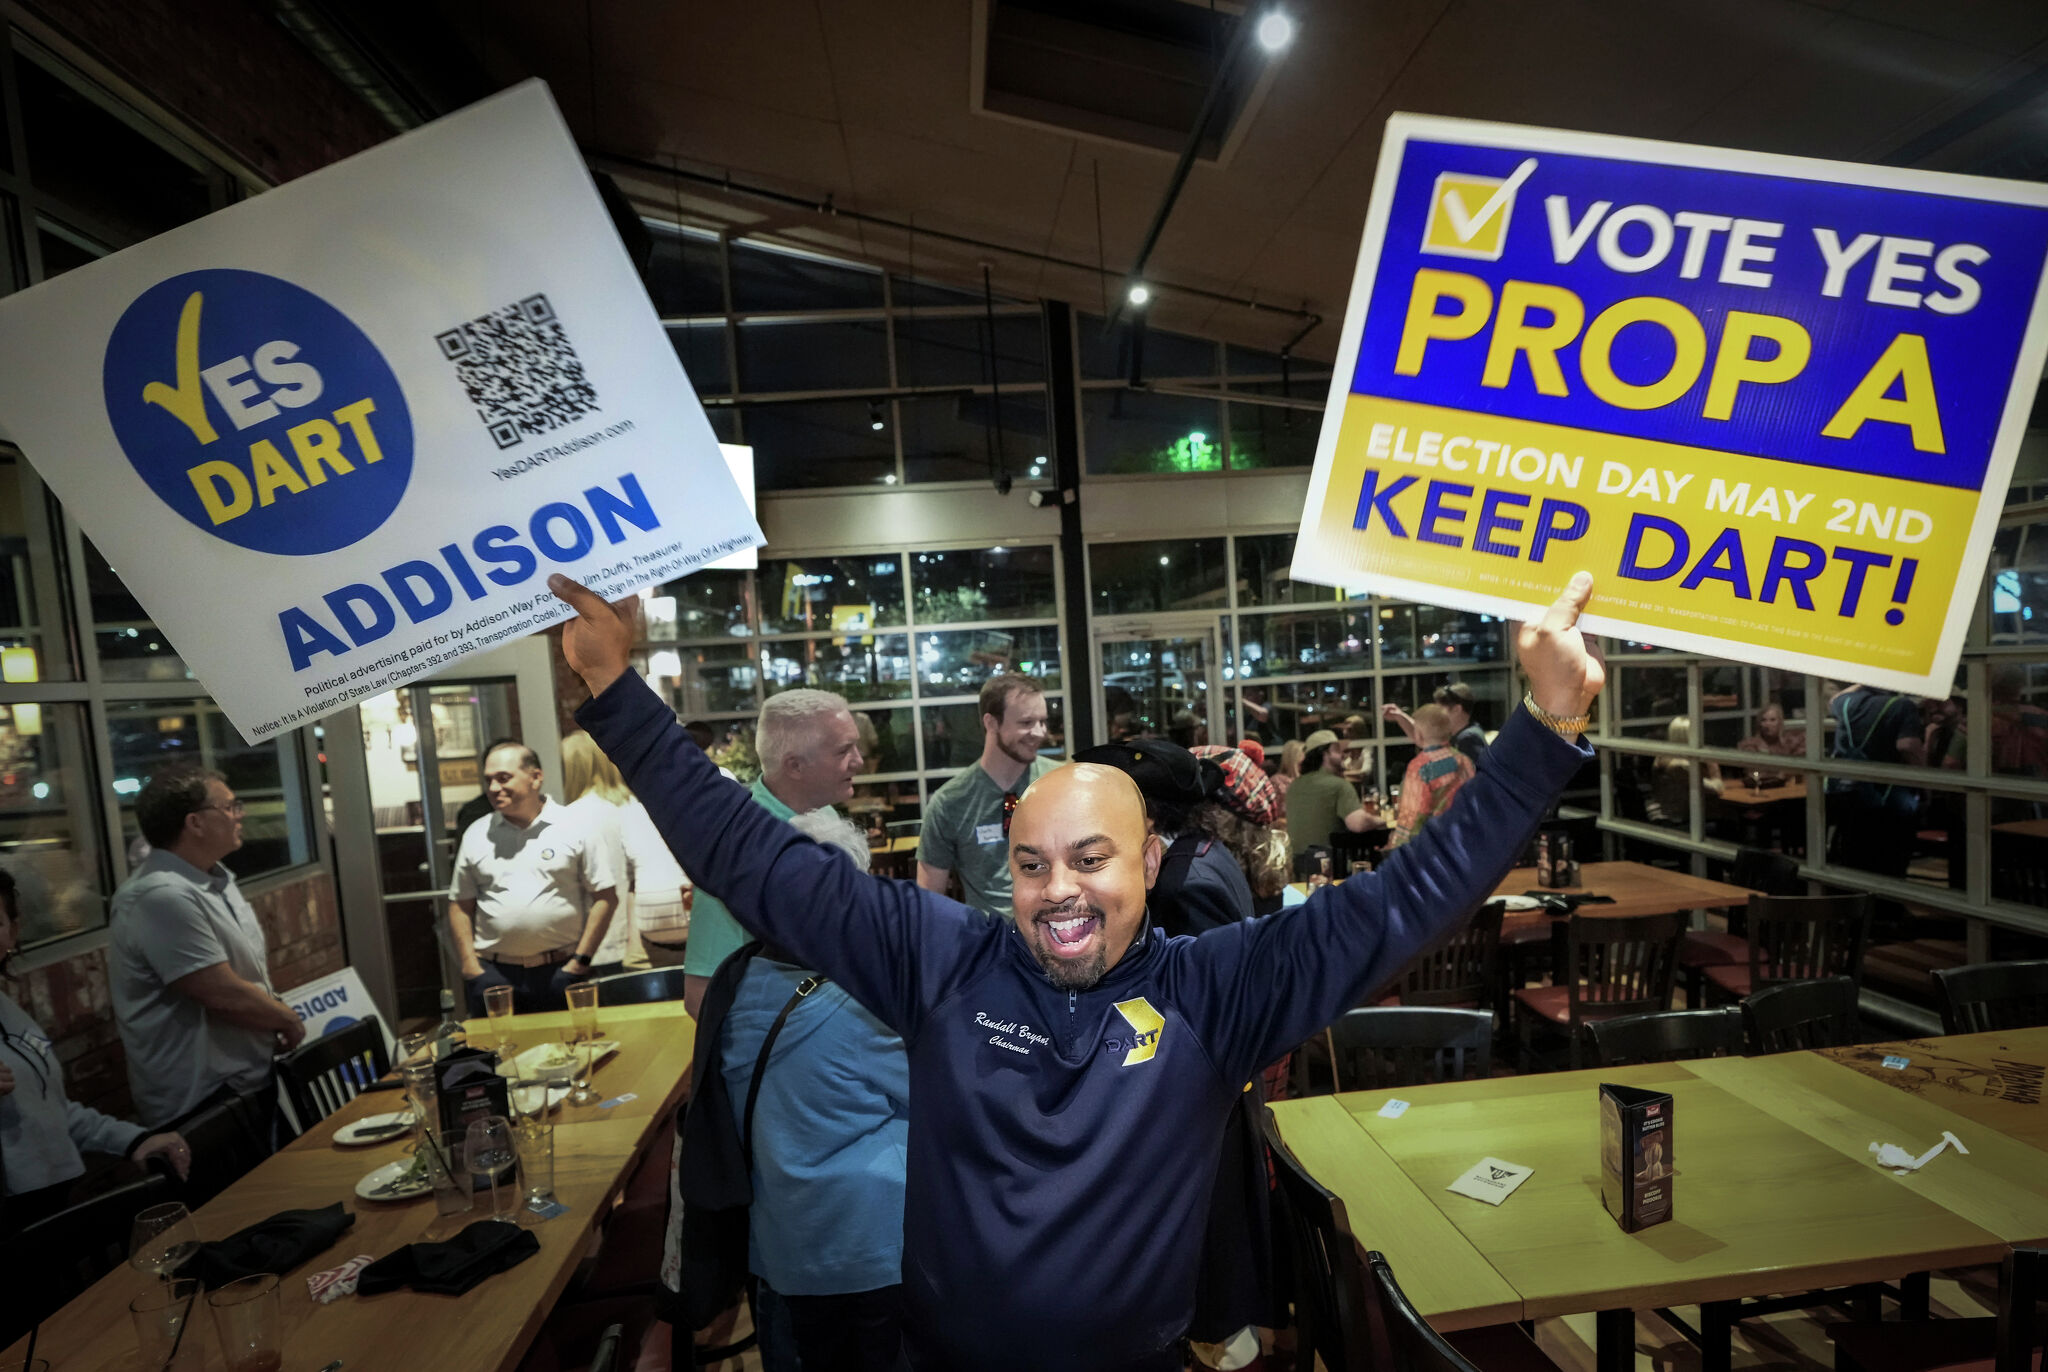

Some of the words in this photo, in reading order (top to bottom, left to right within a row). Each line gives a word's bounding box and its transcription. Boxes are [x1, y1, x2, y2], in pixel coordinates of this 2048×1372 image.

[1545, 195, 1784, 289] VOTE
[1813, 228, 1991, 315] YES
[143, 290, 324, 446] YES
[1394, 268, 1811, 421] PROP
[1821, 333, 1946, 455] A
[186, 397, 384, 526] DART
[492, 422, 635, 480] YesDARTAddison.com
[1367, 423, 1585, 490] ELECTION
[1597, 462, 1694, 504] DAY
[1704, 482, 1814, 524] MAY
[1826, 498, 1933, 545] 2ND
[278, 473, 661, 673] ADDISON
[583, 573, 601, 588] Jim
[632, 542, 681, 565] Treasurer
[607, 582, 626, 594] Sign
[625, 578, 635, 587] In
[633, 573, 650, 583] The
[700, 547, 711, 559] Of
[1352, 468, 1591, 563] KEEP
[1618, 513, 1920, 627] DART!
[251, 719, 282, 736] Notice:
[280, 715, 289, 725] It
[287, 713, 297, 722] Is
[296, 709, 304, 719] A
[304, 697, 338, 715] Violation
[338, 690, 349, 701] Of
[348, 684, 370, 697] State
[369, 677, 387, 689] Law
[387, 662, 426, 684] (Chapters
[425, 654, 443, 666] 392
[442, 647, 459, 660] and
[457, 641, 477, 654] 393,
[475, 619, 533, 646] Transportation
[558, 601, 571, 612] To
[304, 673, 348, 697] Political
[349, 650, 409, 679] advertising
[408, 638, 432, 658] paid
[433, 634, 448, 645] for
[449, 628, 463, 639] by
[466, 610, 509, 633] Addison
[508, 600, 533, 614] Way
[292, 986, 349, 1022] ADDIS
[975, 1011, 1018, 1036] Randall
[1020, 1025, 1050, 1047] Bryant
[989, 1036, 1030, 1056] Chairman
[1105, 1028, 1159, 1055] DART
